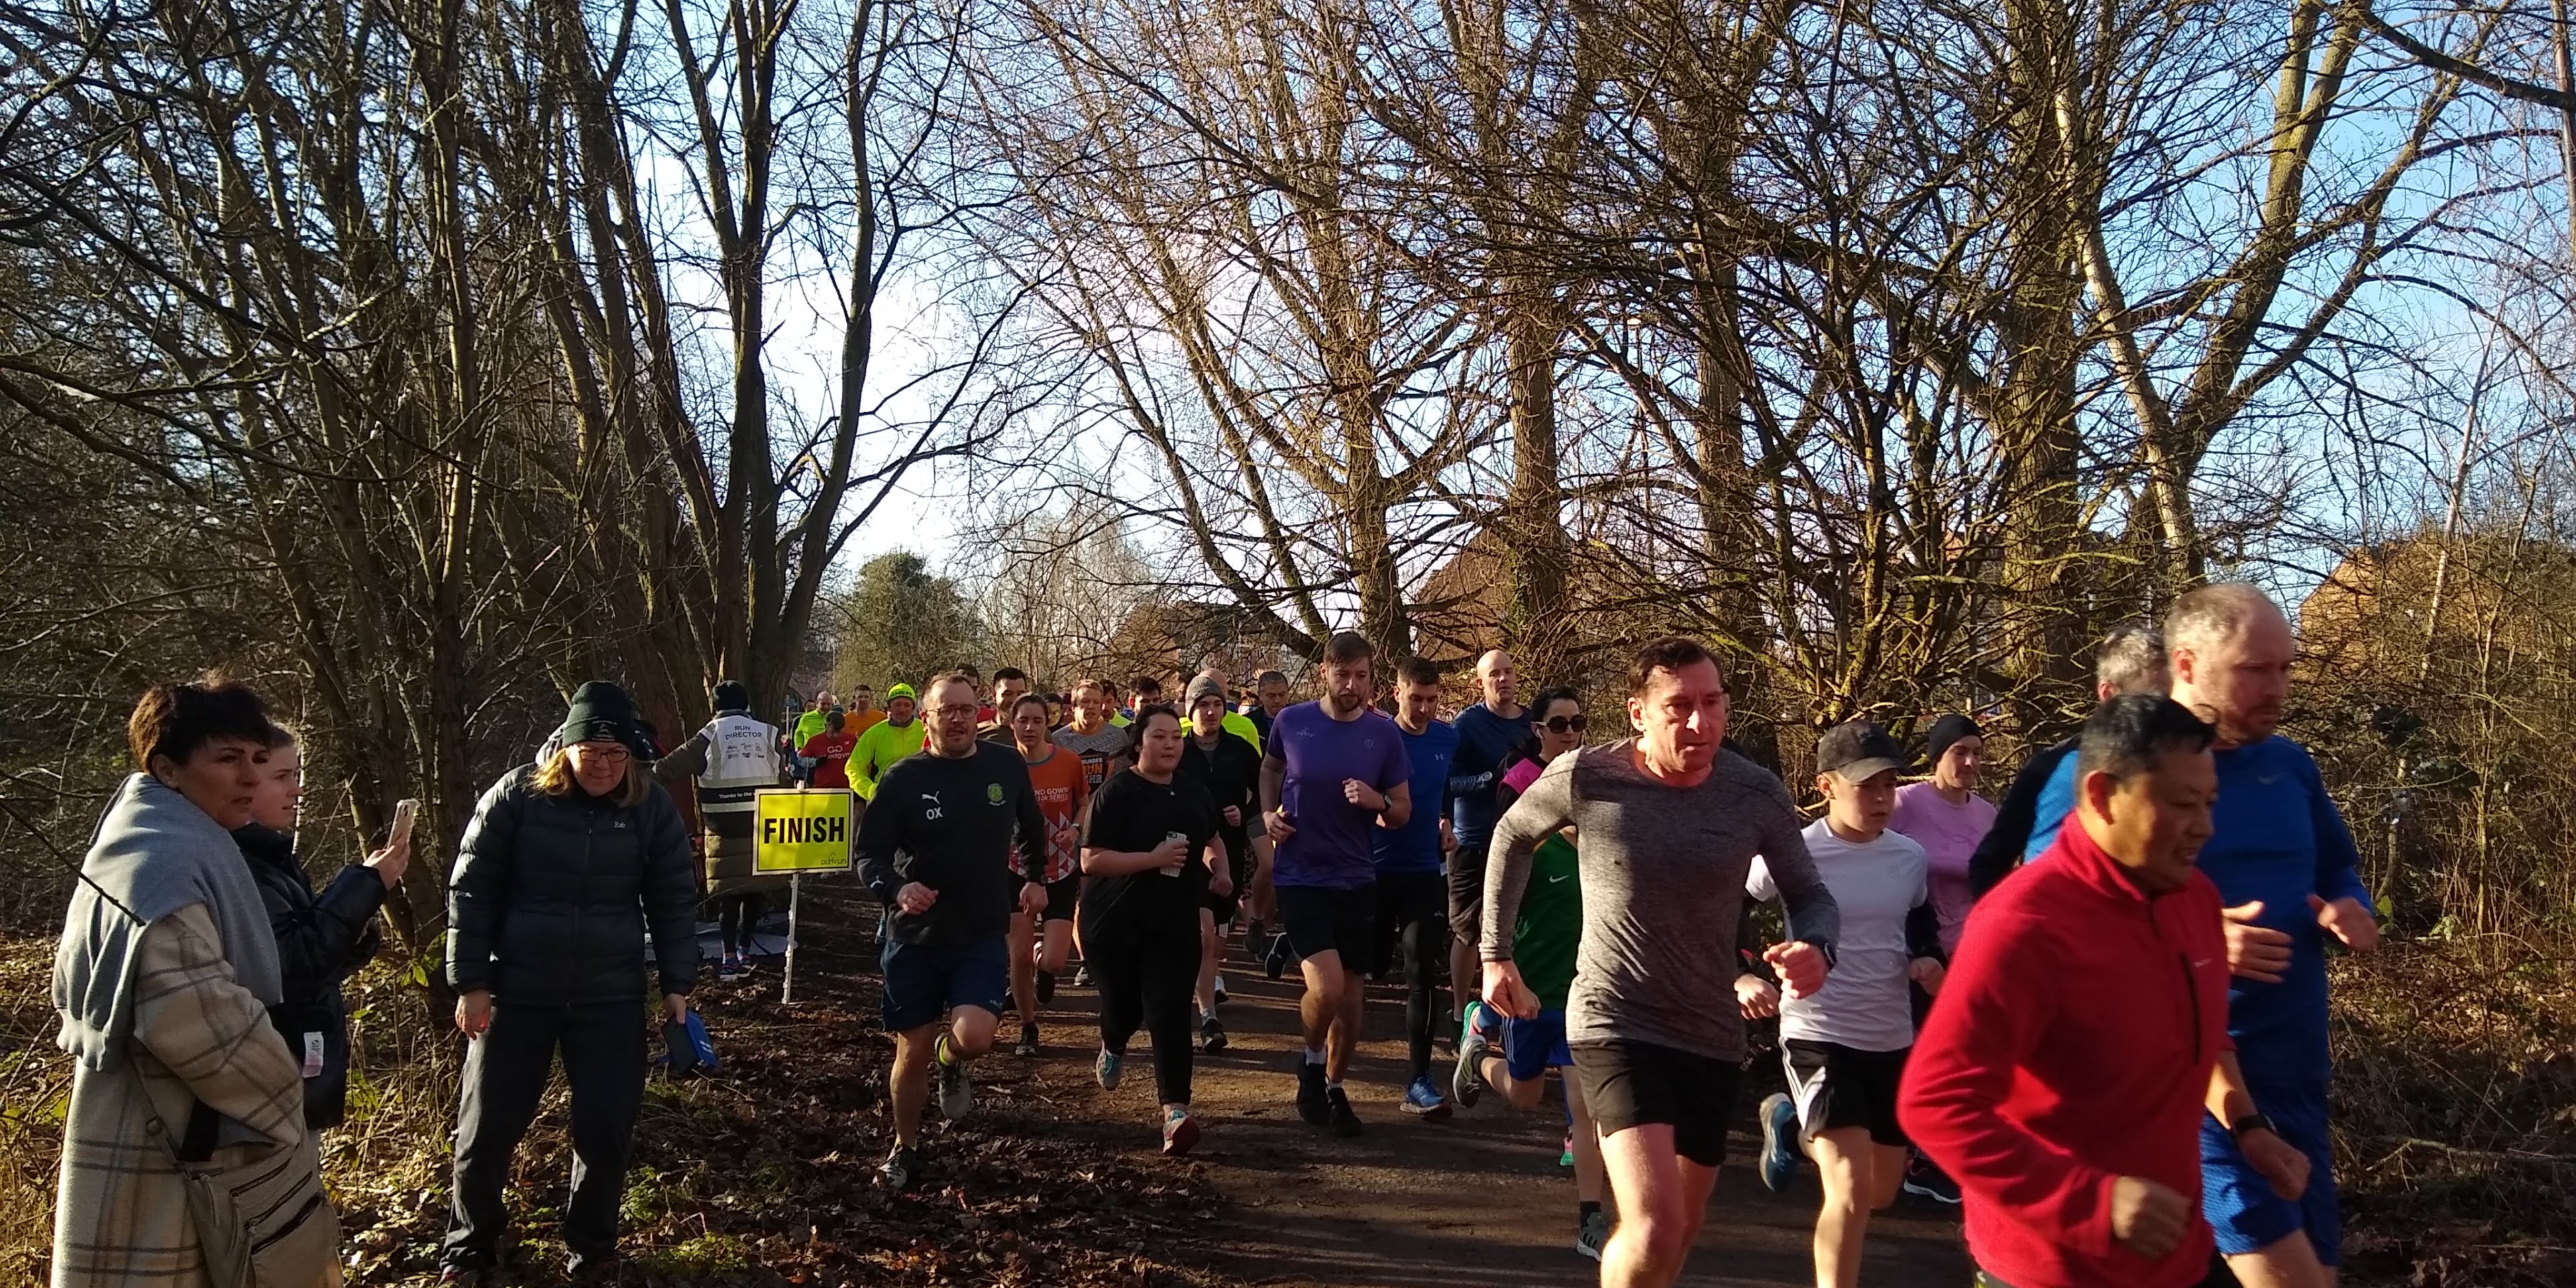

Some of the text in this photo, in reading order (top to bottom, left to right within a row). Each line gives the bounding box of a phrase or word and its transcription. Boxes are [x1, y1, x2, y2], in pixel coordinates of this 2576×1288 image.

[725, 731, 762, 740] DIRECTOR
[1046, 787, 1069, 795] GOWN
[926, 806, 944, 820] OX
[764, 816, 845, 844] FINISH
[820, 856, 847, 865] parkrun
